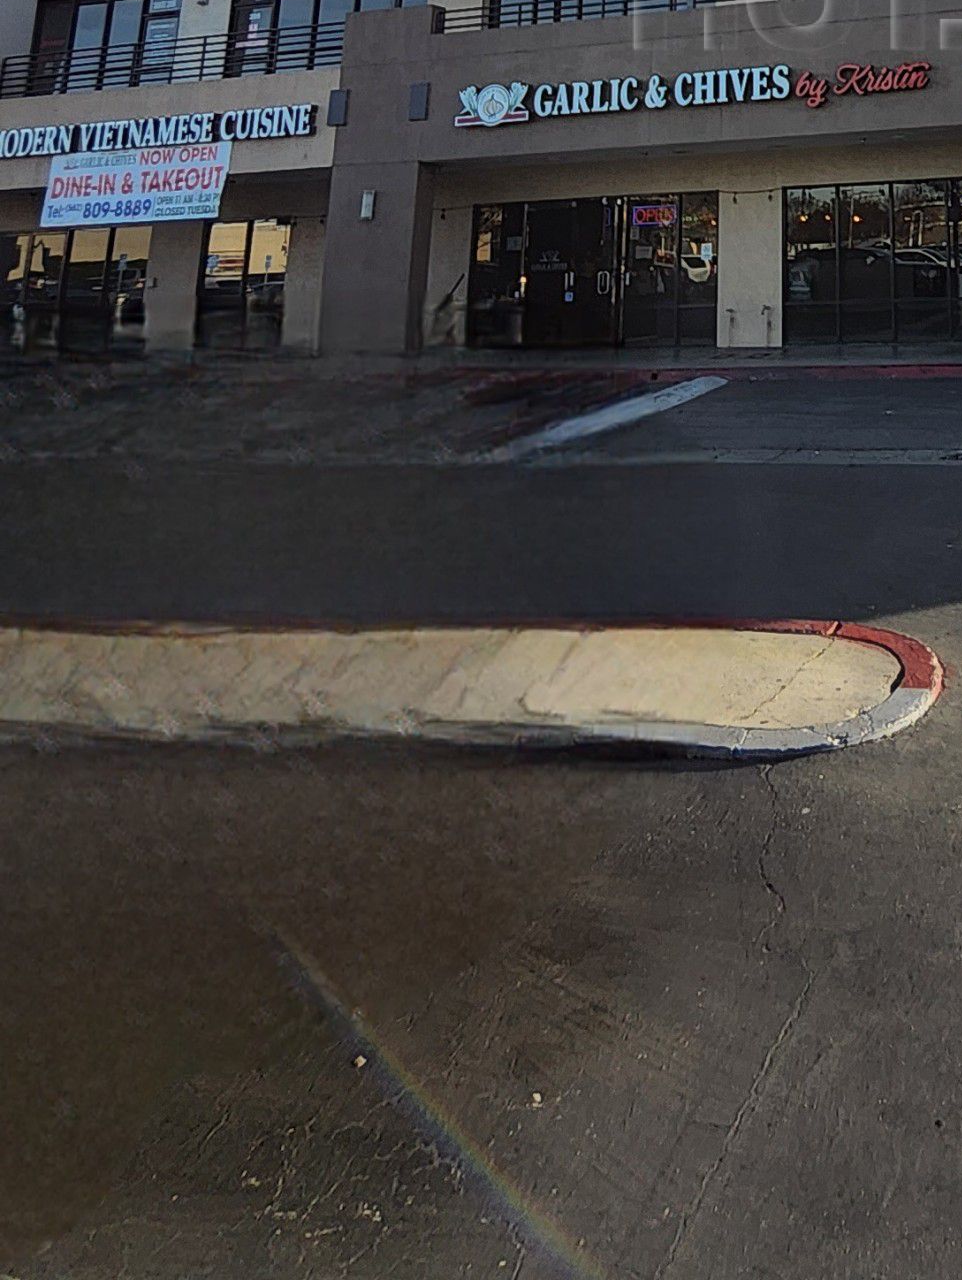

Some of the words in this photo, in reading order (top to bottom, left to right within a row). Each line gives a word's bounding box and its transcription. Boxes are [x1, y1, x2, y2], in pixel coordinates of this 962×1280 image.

[533, 76, 637, 117] GARLIC
[644, 74, 667, 107] &
[674, 65, 791, 107] CHIVES
[795, 72, 828, 108] by
[833, 62, 930, 96] Kristin
[80, 112, 215, 152] VIETNAMESE
[219, 104, 313, 141] CUISINE
[139, 148, 175, 166] NOW
[178, 146, 218, 163] OPEN
[50, 173, 116, 199] DINE-IN
[121, 172, 134, 195] &
[141, 166, 224, 195] TAKEOUT
[83, 199, 152, 219] 809-8889
